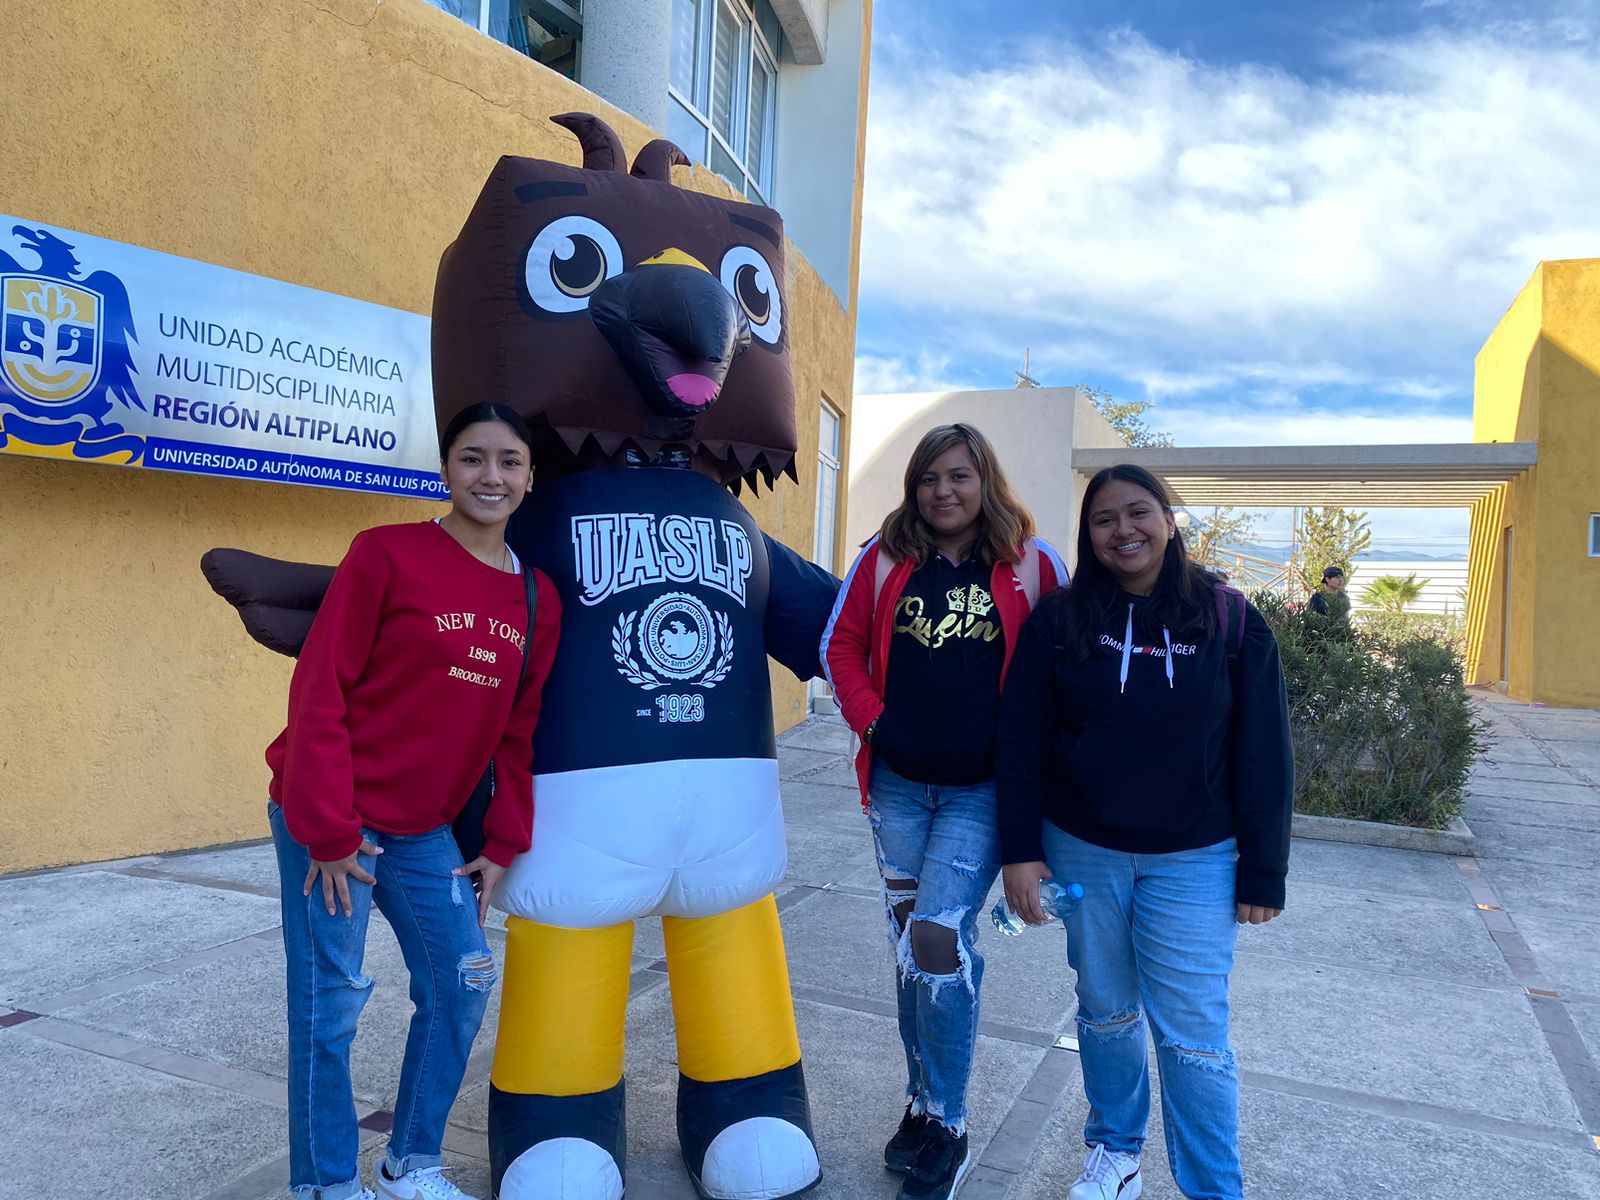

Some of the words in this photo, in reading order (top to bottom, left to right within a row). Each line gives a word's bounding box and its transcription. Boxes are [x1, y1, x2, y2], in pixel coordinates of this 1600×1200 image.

[159, 312, 264, 354] UNIDAD
[269, 337, 403, 383] ACADÉMICA
[156, 353, 396, 417] MULTIDISCIPLINARIA
[153, 394, 260, 432] REGIÓN
[264, 412, 397, 451] ALTIPLANO
[153, 447, 258, 472] UNIVERSIDAD
[261, 460, 341, 481] AUTÓNOMA
[344, 470, 362, 484] DE
[365, 472, 391, 487] SAN
[392, 475, 418, 490] LUIS
[570, 513, 753, 608] UASLP
[434, 612, 476, 632] NEW
[651, 603, 684, 637] UNIVERSIDAD
[468, 646, 497, 664] 1898
[1099, 634, 1135, 652] OMM
[1150, 643, 1197, 657] HILIGER
[448, 666, 502, 688] BROOKLYN
[636, 708, 652, 717] SINCE
[655, 693, 705, 723] 1923
